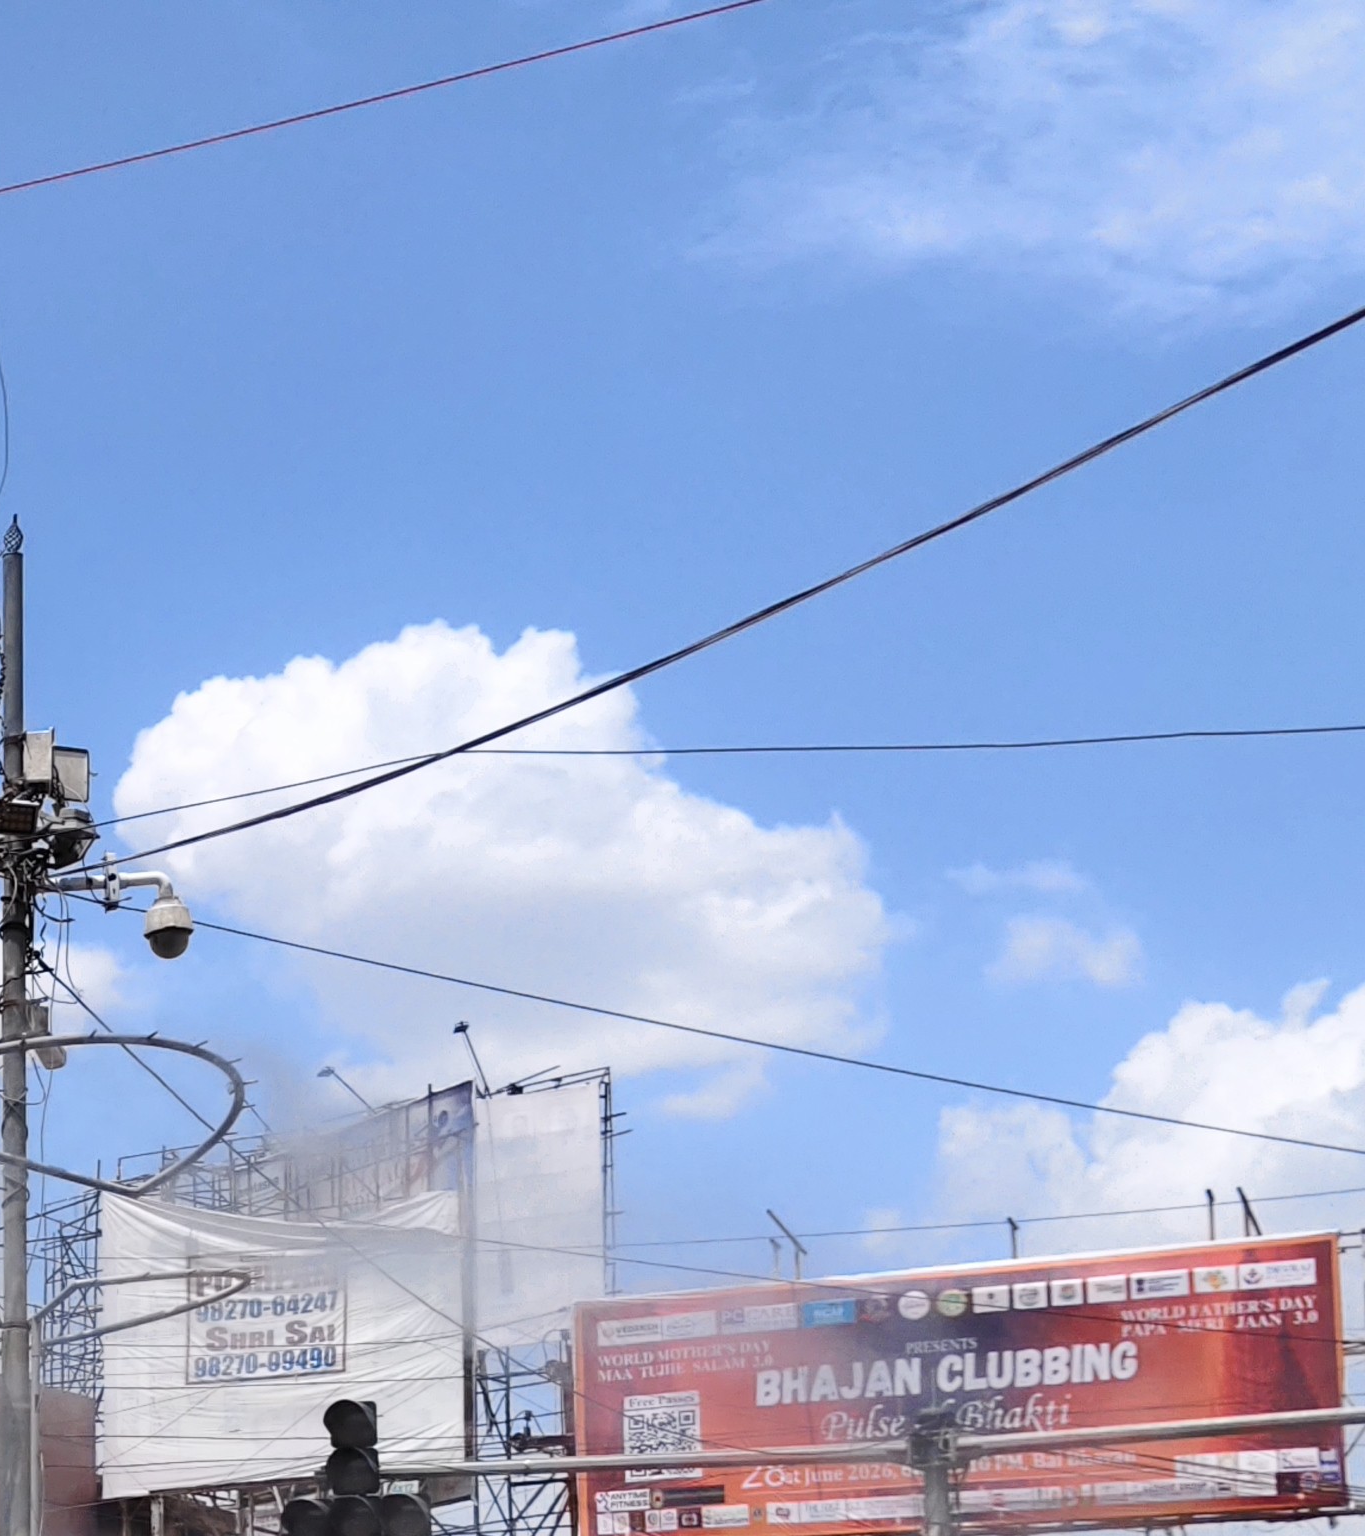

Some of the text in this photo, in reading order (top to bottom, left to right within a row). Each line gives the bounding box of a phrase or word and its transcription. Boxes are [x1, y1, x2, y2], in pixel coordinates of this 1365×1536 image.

[1120, 1304, 1186, 1322] WORLD
[1279, 1294, 1317, 1311] DAY
[1120, 1323, 1167, 1338] PAPA
[1234, 1313, 1283, 1329] JAAN
[598, 1351, 654, 1367] WORLD
[598, 1368, 633, 1382] MAA
[756, 1341, 1138, 1407] BHAJAN CLUBBING
[821, 1404, 906, 1440] Pulse
[955, 1393, 1072, 1432] Bhakti
